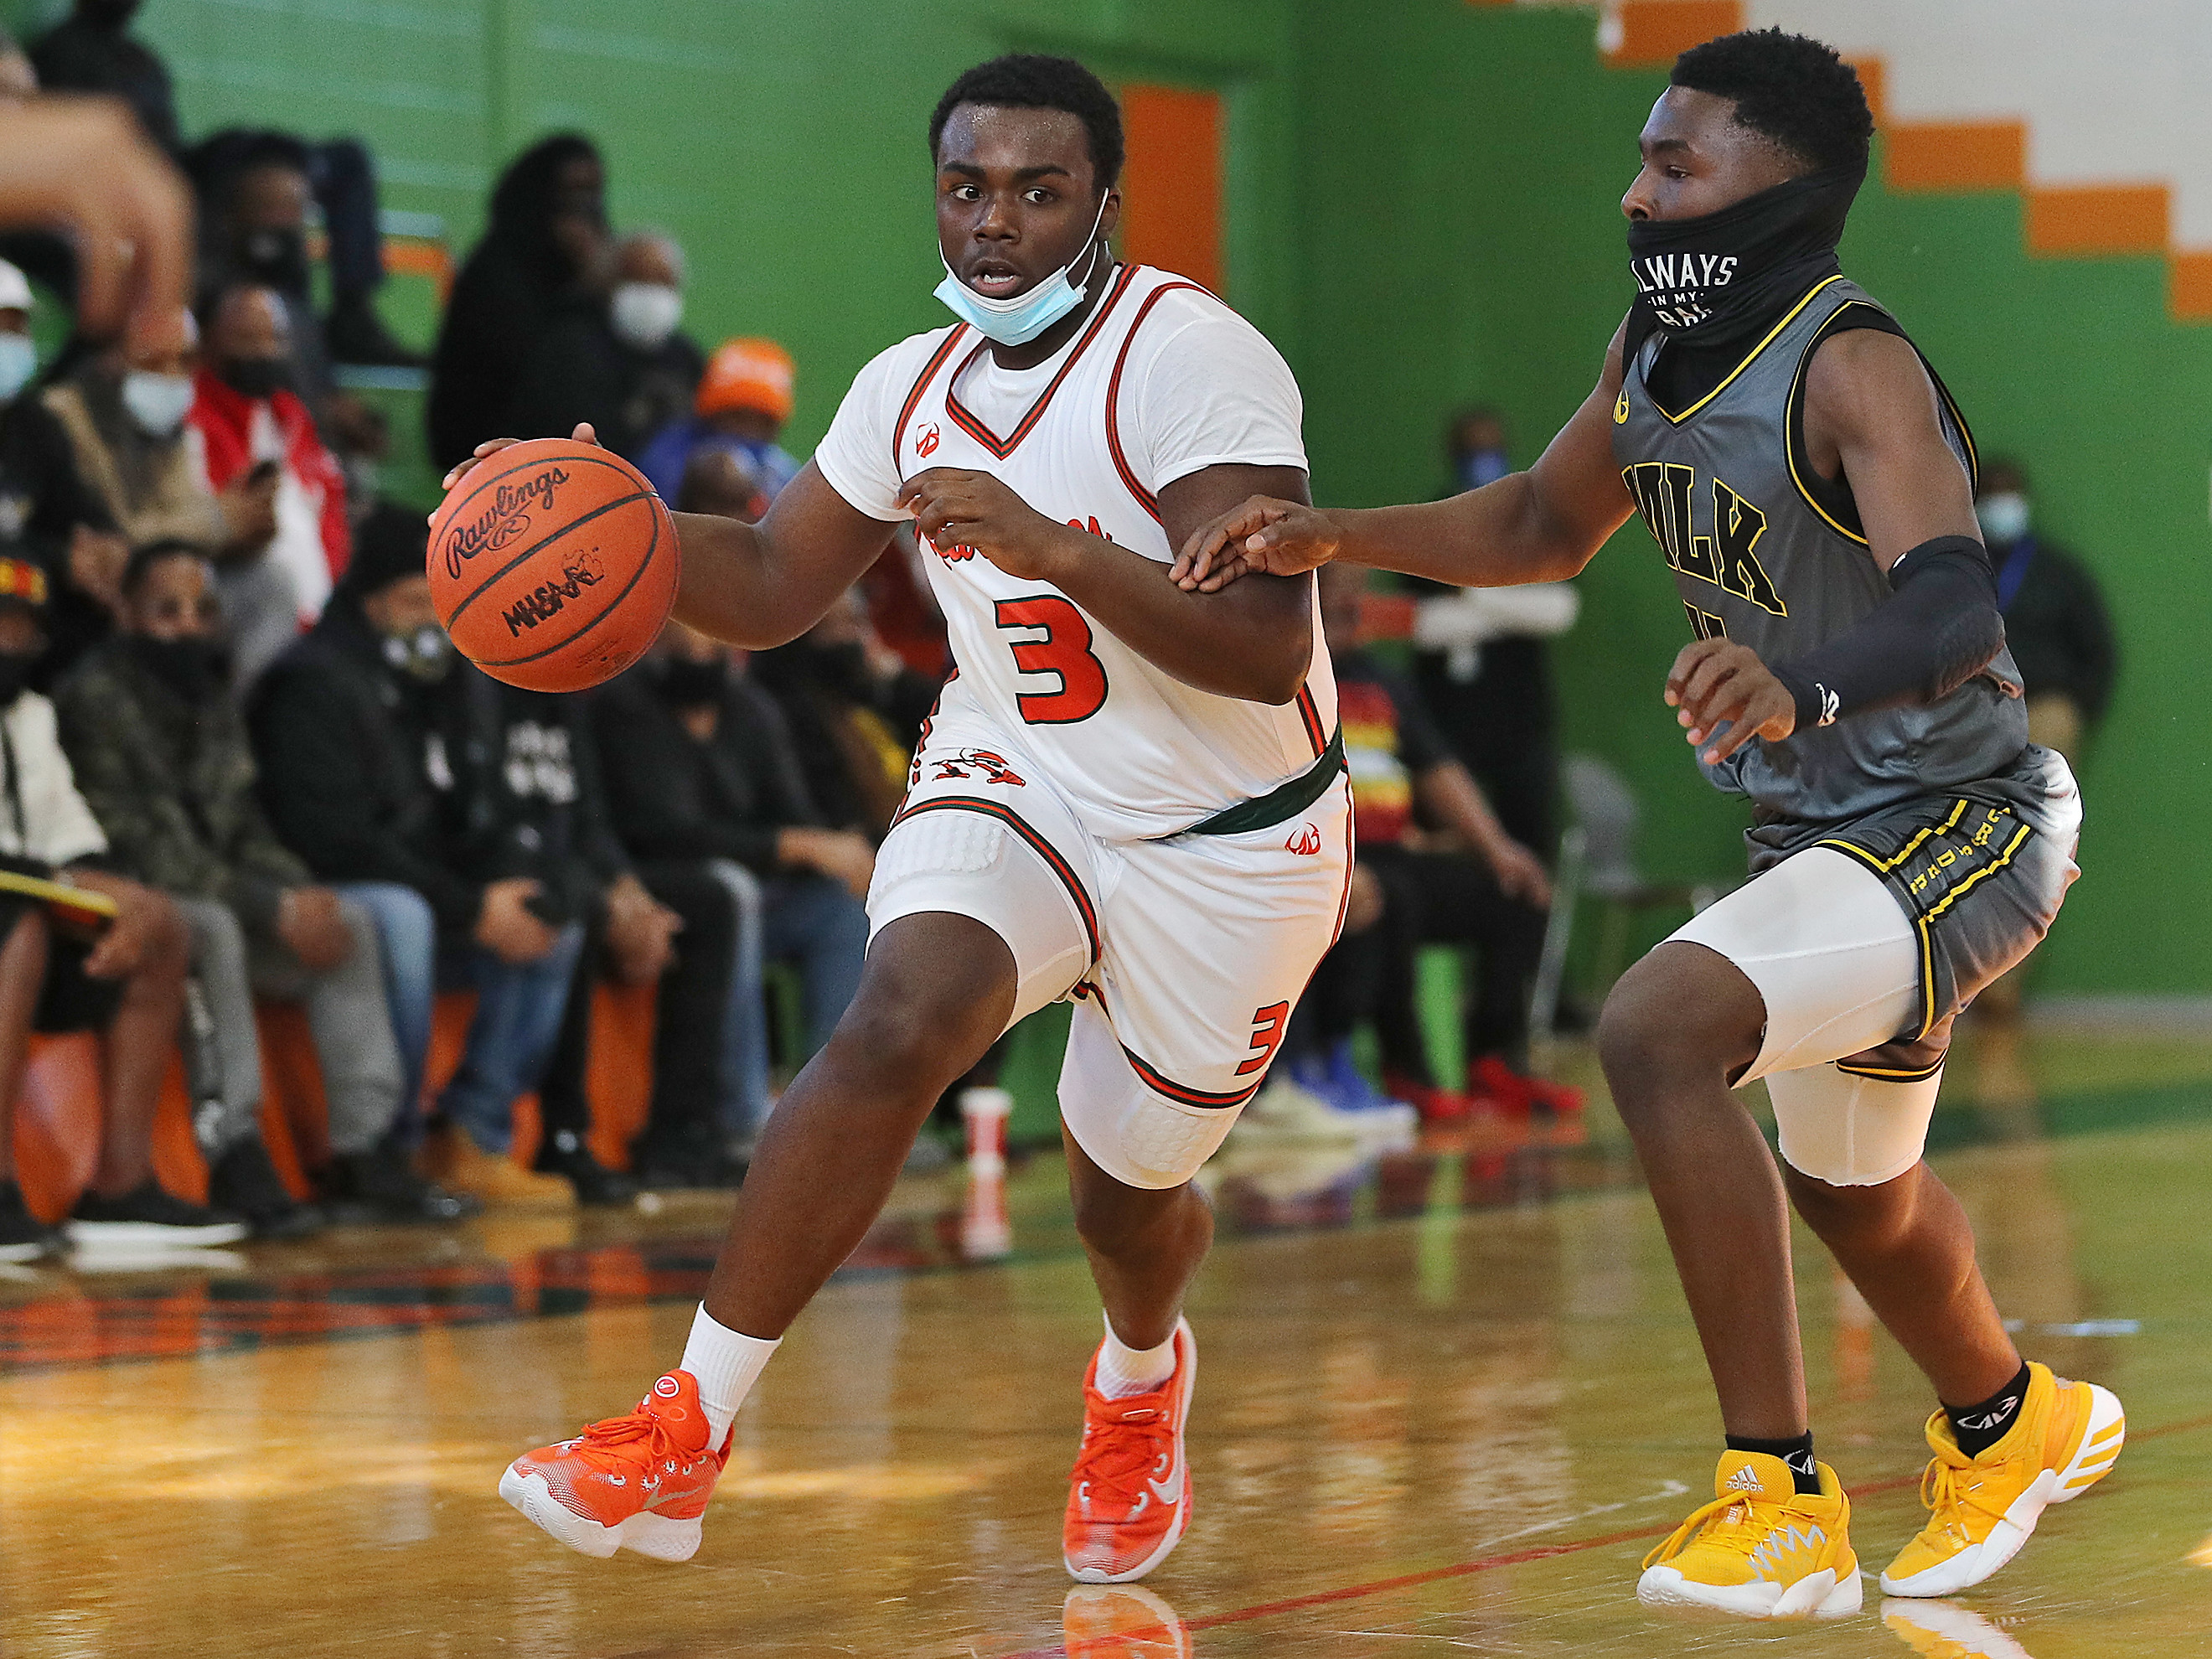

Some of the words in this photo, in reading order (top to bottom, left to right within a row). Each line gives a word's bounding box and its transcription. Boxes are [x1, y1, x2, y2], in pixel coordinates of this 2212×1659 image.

[1631, 254, 1738, 292] LWAYS
[446, 468, 570, 580] Rawlings
[993, 594, 1109, 725] 3
[1233, 1000, 1289, 1077] 3
[1725, 1480, 1764, 1492] adidas
